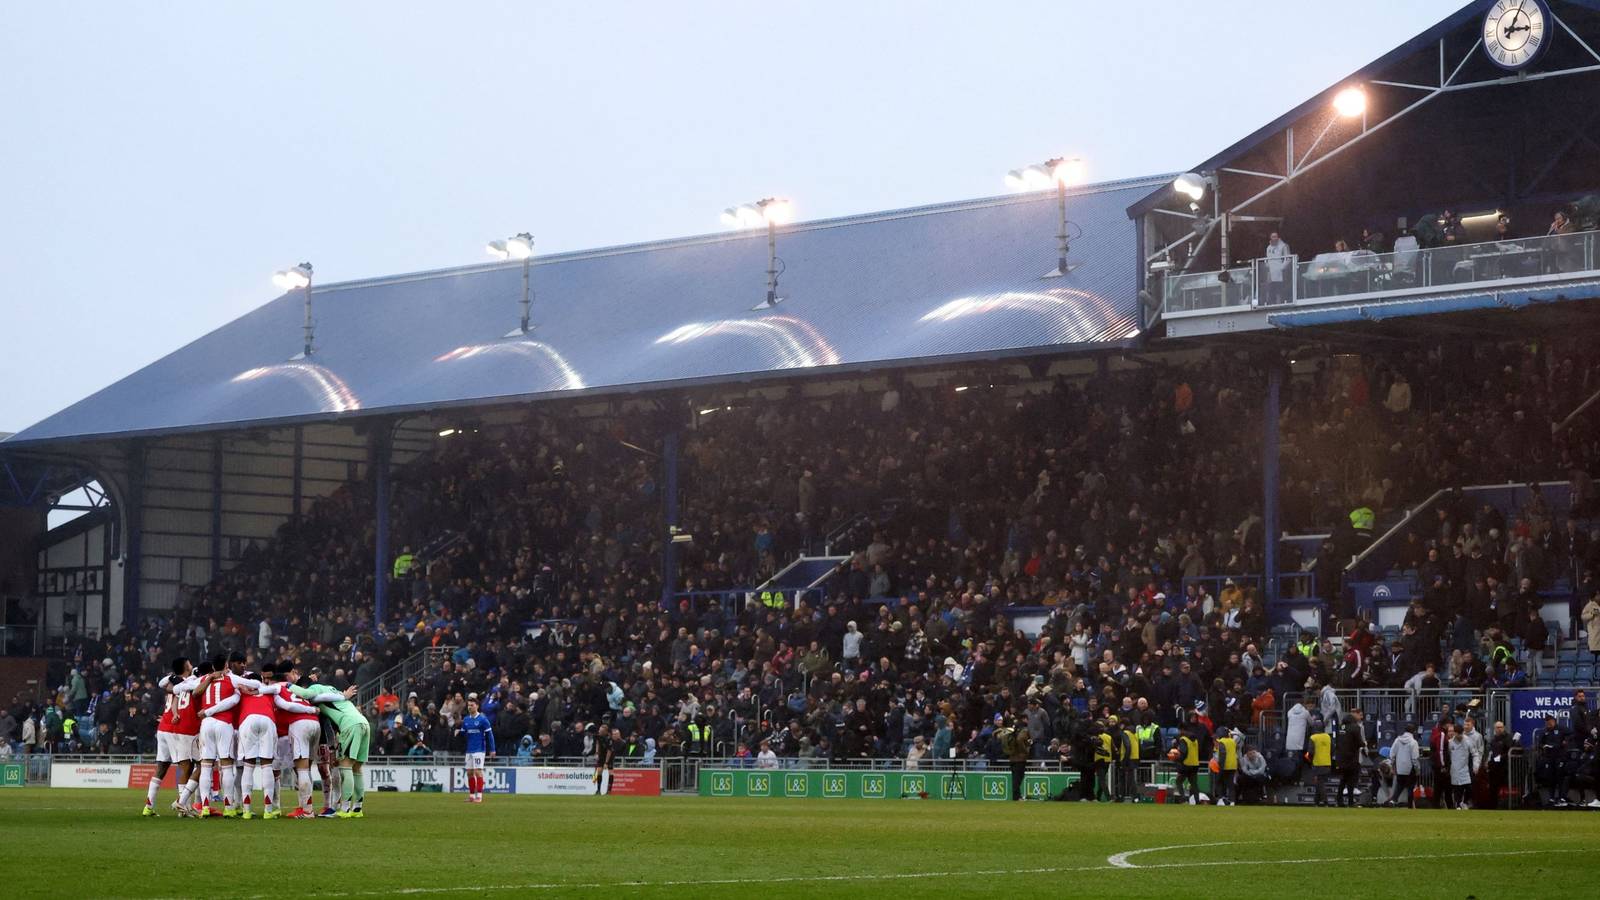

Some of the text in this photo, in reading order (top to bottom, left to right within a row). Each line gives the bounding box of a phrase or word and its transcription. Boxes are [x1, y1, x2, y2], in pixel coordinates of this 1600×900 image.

[206, 682, 221, 704] 11
[1535, 697, 1574, 706] WE ARE
[1520, 710, 1570, 719] PORTSMO
[6, 770, 18, 780] L&S
[75, 767, 121, 775] stadiumsolutions
[412, 768, 438, 785] pmc
[538, 771, 594, 781] stadiumsolution
[371, 769, 397, 788] pmc
[713, 777, 731, 791] L&S
[750, 778, 768, 791] L&S
[787, 778, 805, 792] L&S
[825, 779, 844, 792] L&S
[865, 780, 883, 793] L&S
[904, 780, 923, 793] L&S
[944, 781, 963, 794] L&S
[985, 781, 1005, 795] L&S
[1027, 782, 1048, 796] L&S
